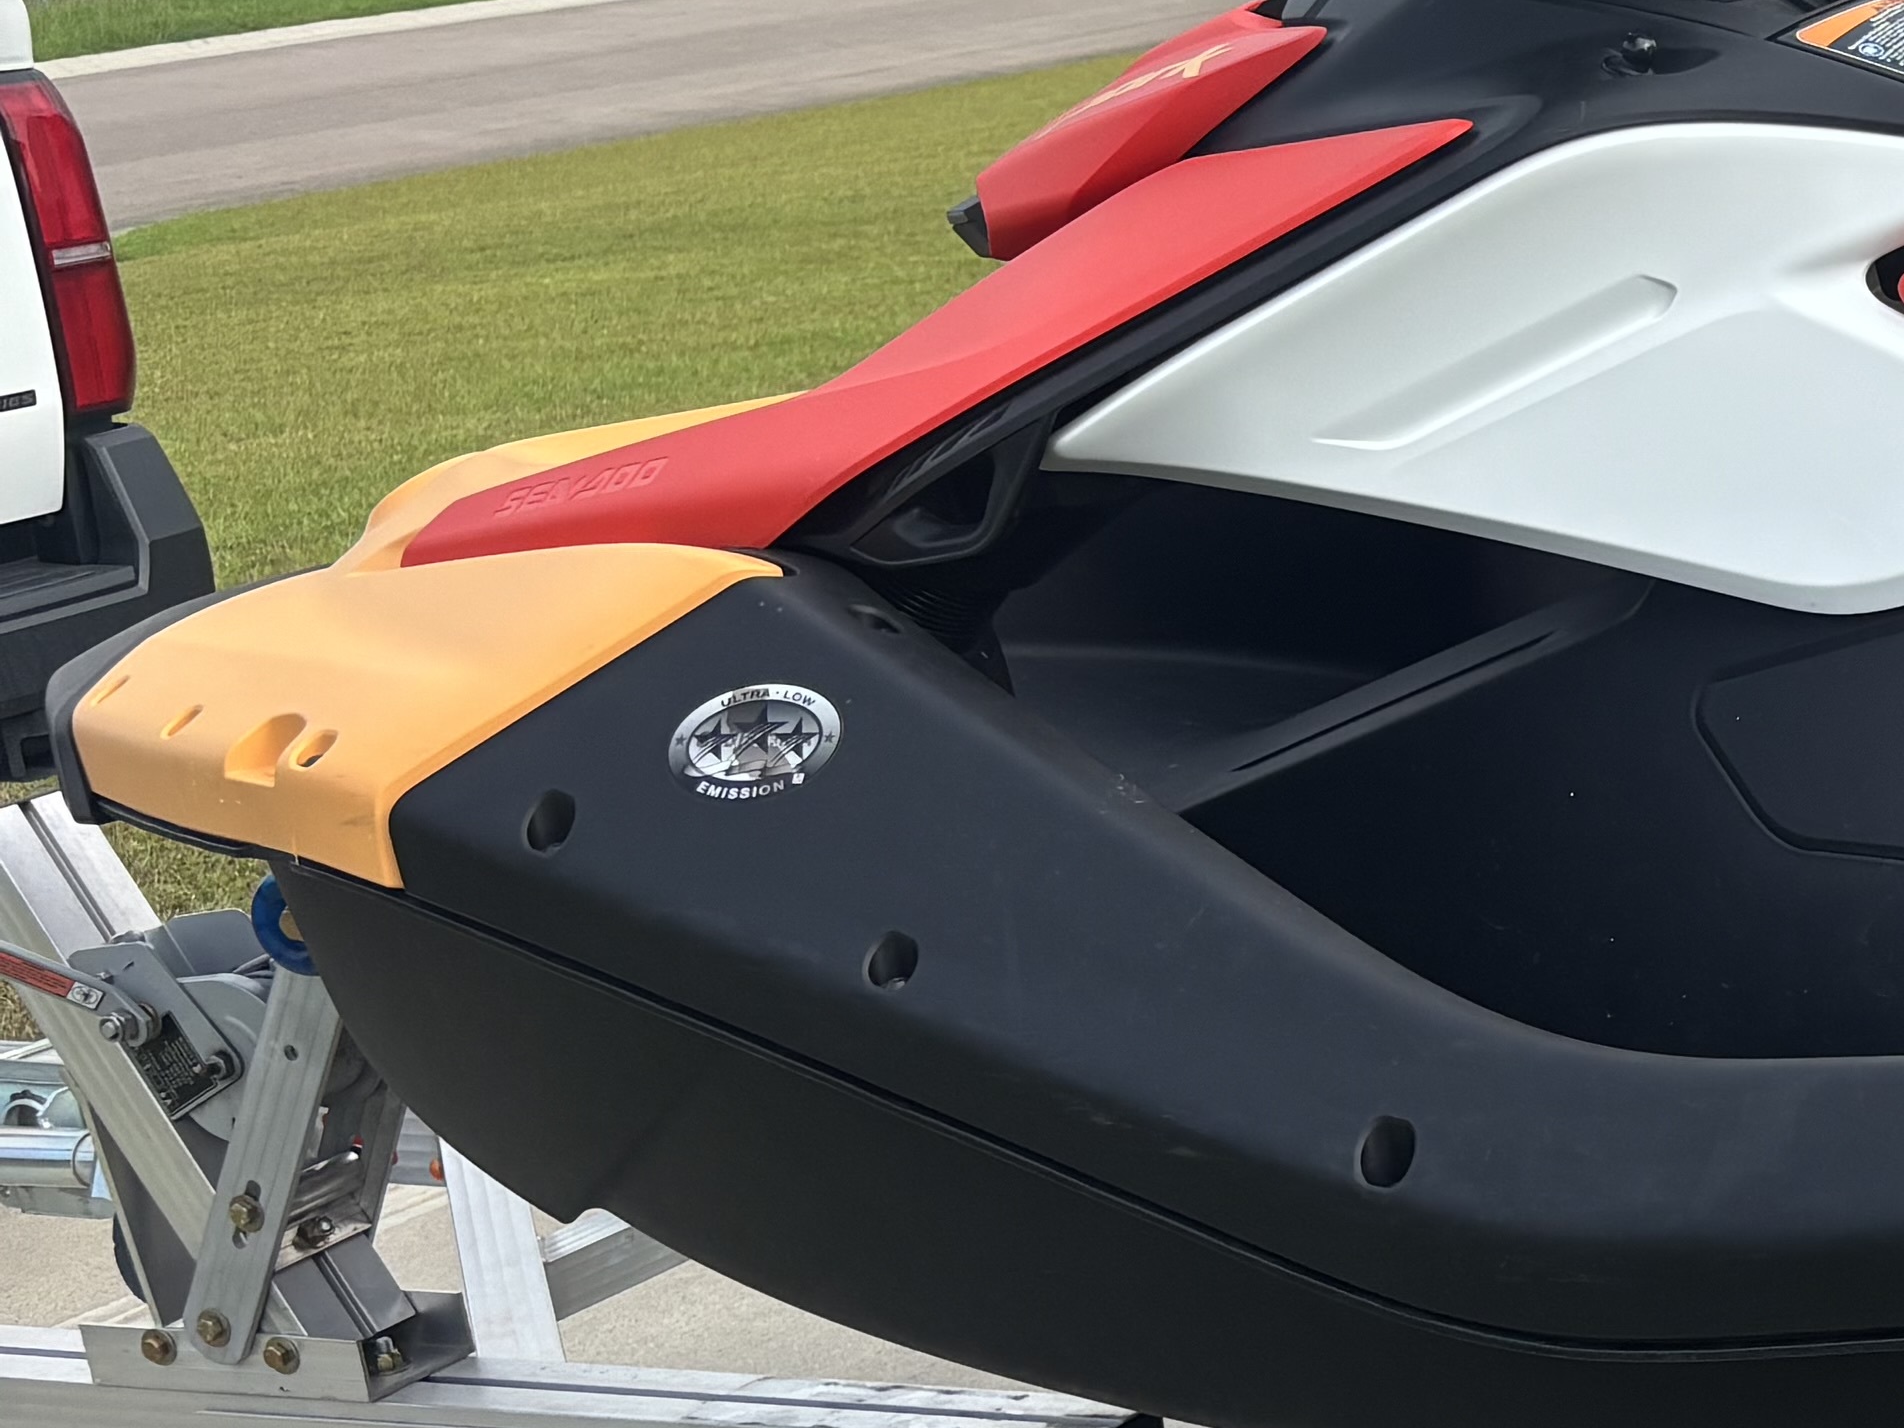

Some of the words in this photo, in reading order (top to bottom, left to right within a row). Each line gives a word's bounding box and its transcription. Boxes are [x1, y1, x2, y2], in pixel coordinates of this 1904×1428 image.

[720, 687, 771, 708] ULTRA
[782, 689, 817, 708] LOW
[696, 780, 786, 801] EMISSION
